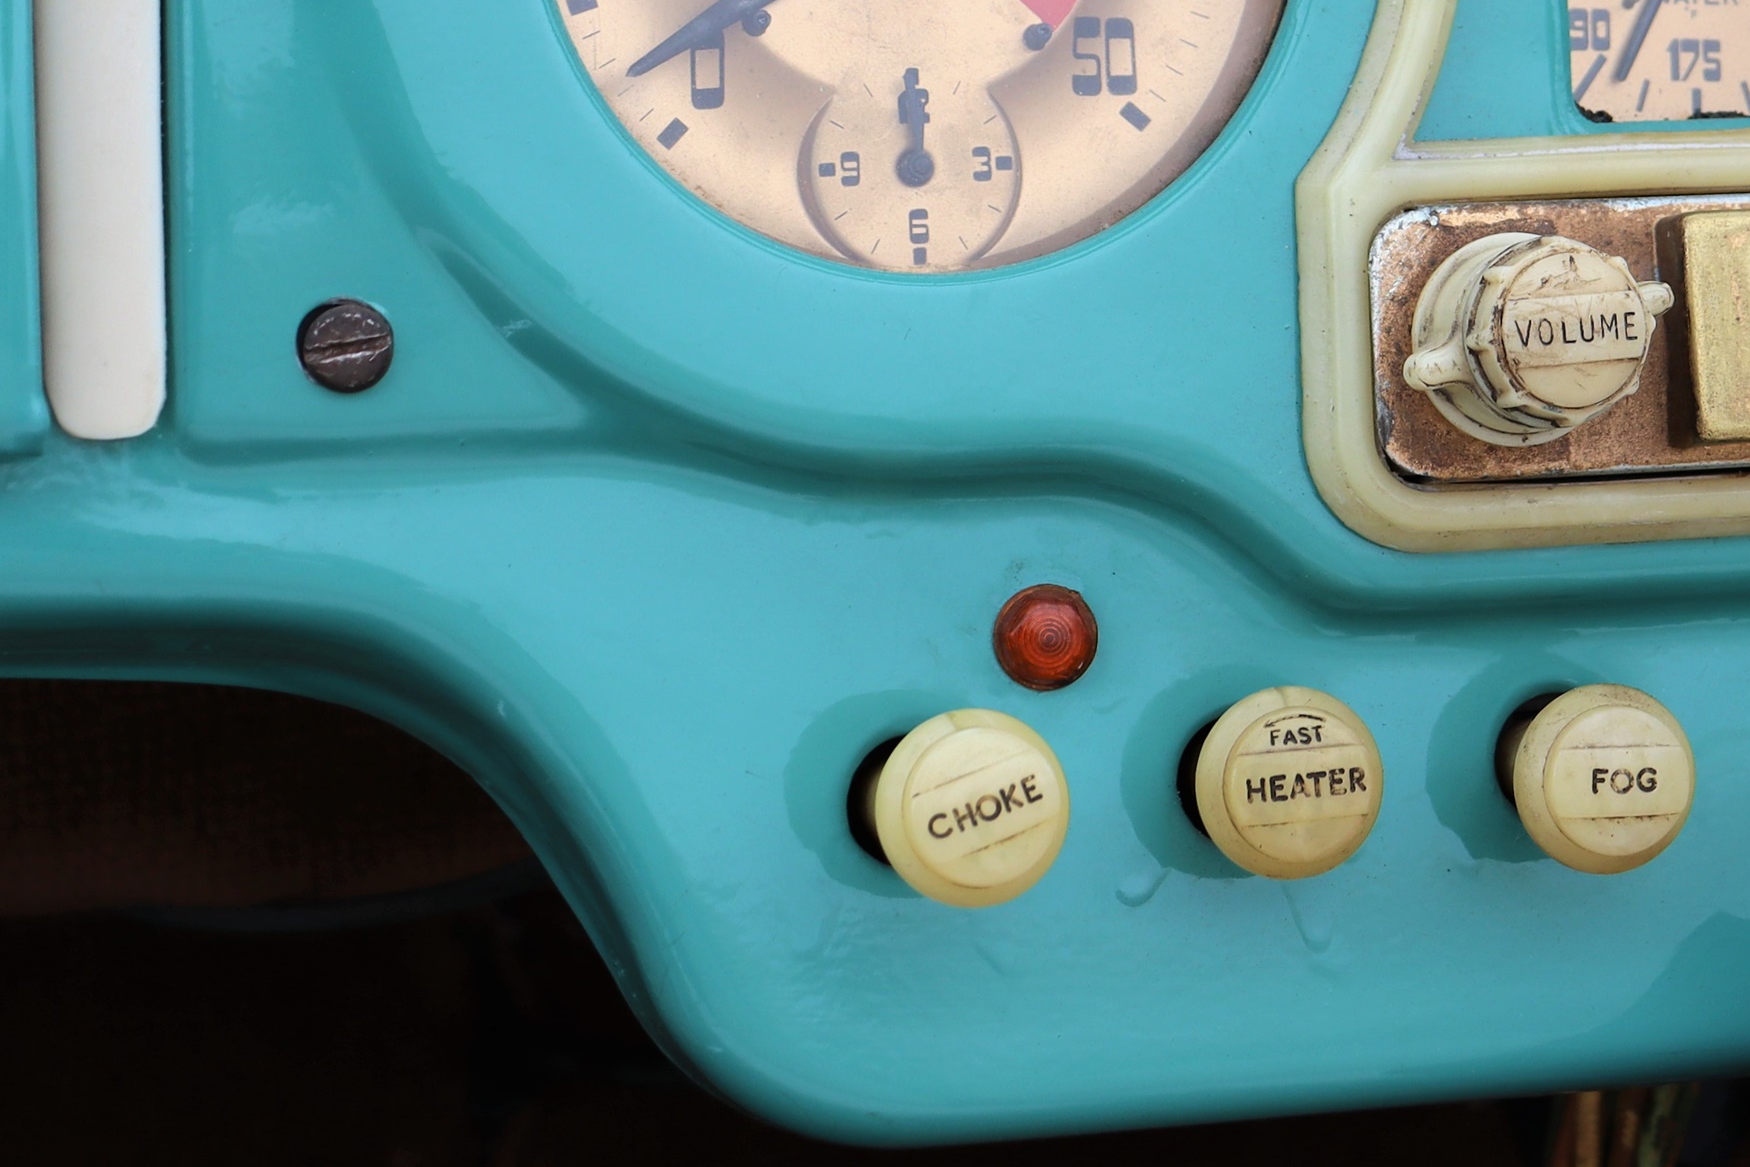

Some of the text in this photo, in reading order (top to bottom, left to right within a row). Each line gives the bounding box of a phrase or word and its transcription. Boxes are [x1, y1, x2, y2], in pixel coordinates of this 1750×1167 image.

[1072, 16, 1139, 96] 50
[1668, 38, 1721, 82] 175
[840, 151, 860, 187] 9
[971, 146, 992, 182] 3
[908, 208, 929, 244] 6
[1515, 311, 1638, 347] VOLUME
[1269, 724, 1325, 746] FAST
[1246, 766, 1367, 803] HEATER
[1591, 768, 1658, 796] FOG
[926, 774, 1044, 840] CHOKE
